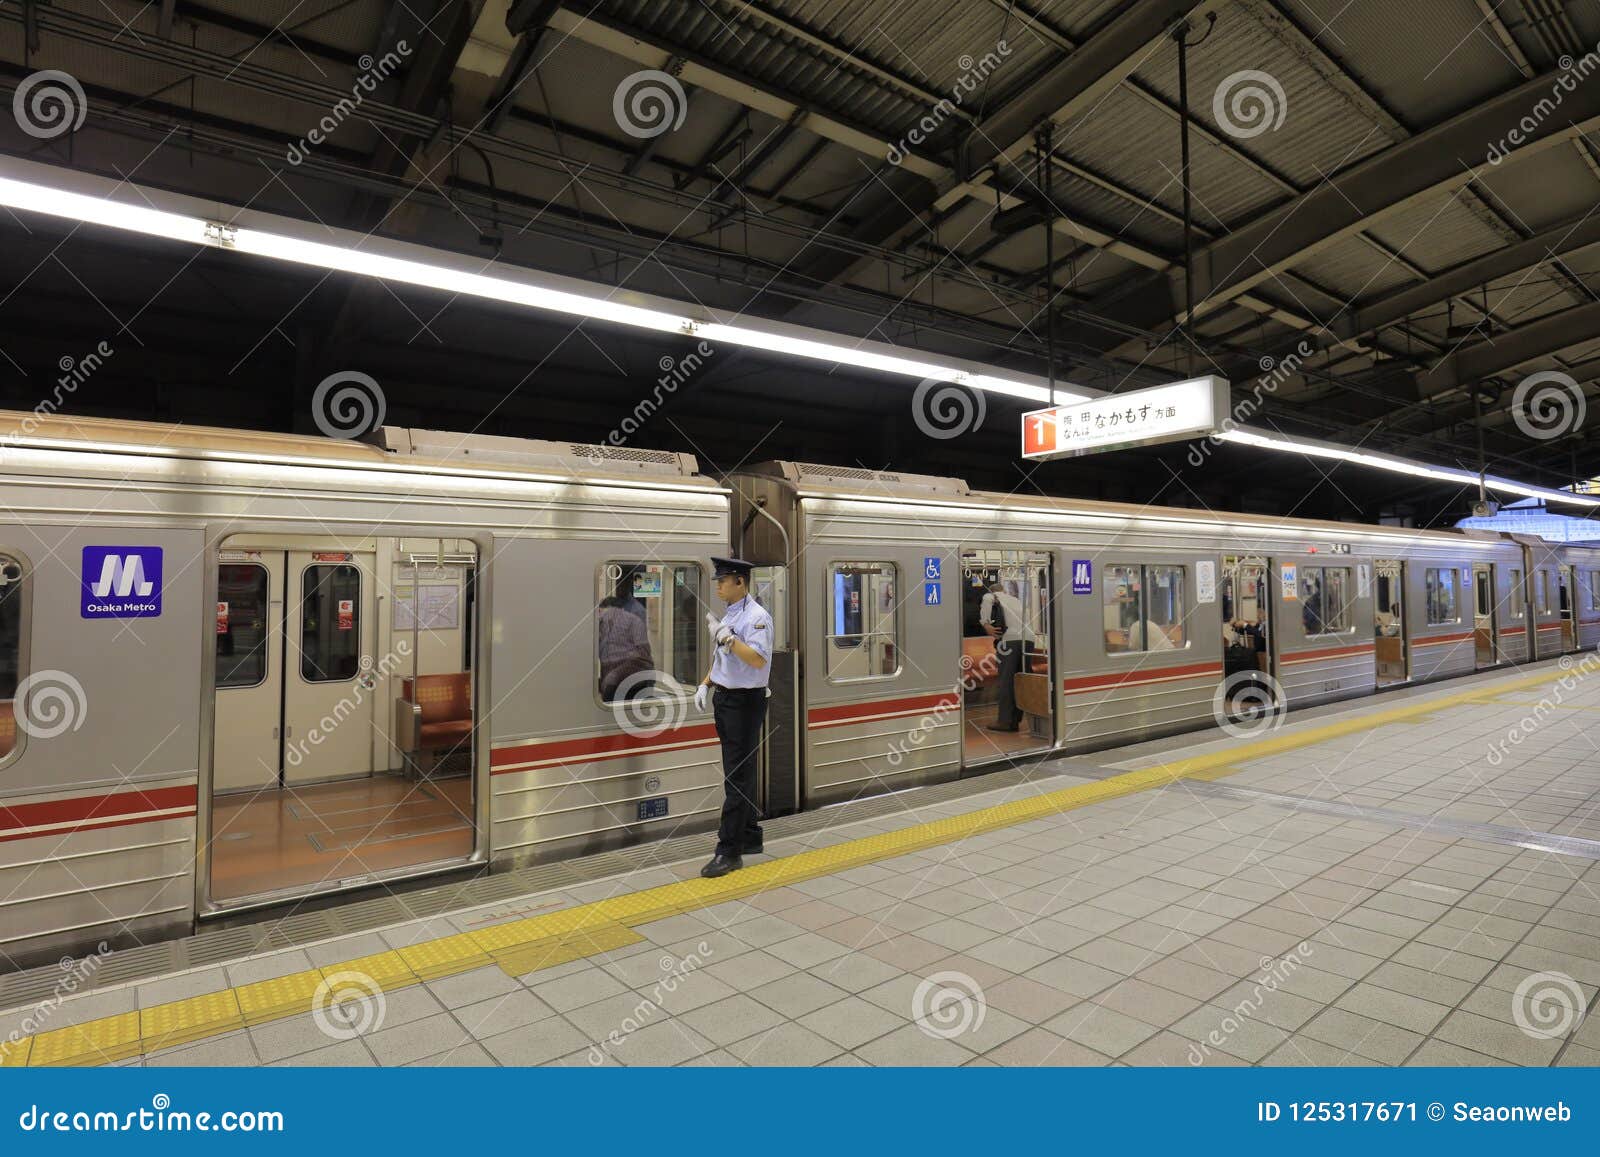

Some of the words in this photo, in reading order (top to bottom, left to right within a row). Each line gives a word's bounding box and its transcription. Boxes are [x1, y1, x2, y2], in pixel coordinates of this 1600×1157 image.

[1033, 419, 1044, 446] 1
[87, 603, 122, 613] Osaka
[124, 603, 156, 612] Metro
